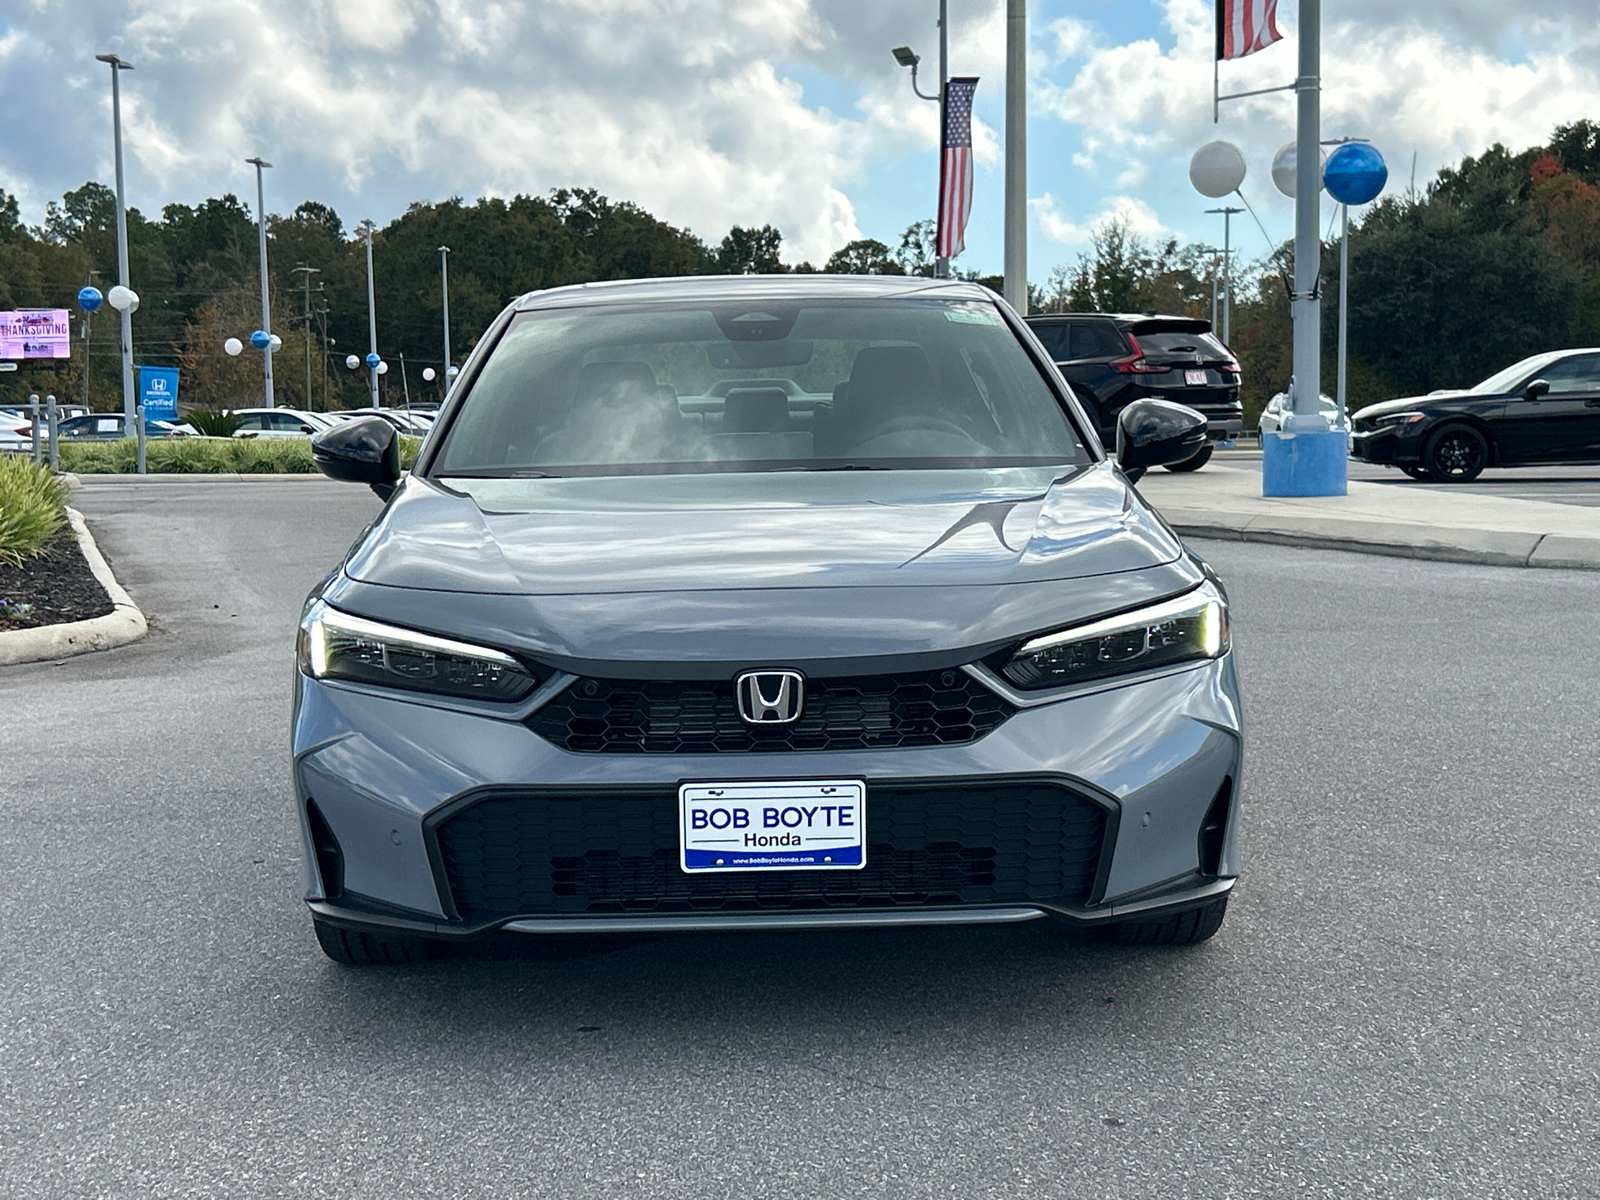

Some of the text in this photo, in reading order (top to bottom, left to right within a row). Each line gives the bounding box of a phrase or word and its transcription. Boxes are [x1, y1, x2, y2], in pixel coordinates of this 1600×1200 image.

[0, 324, 67, 336] THANKSGIVING
[143, 398, 174, 406] Certified
[691, 806, 854, 829] BOB BOYTE
[744, 832, 801, 847] Honda
